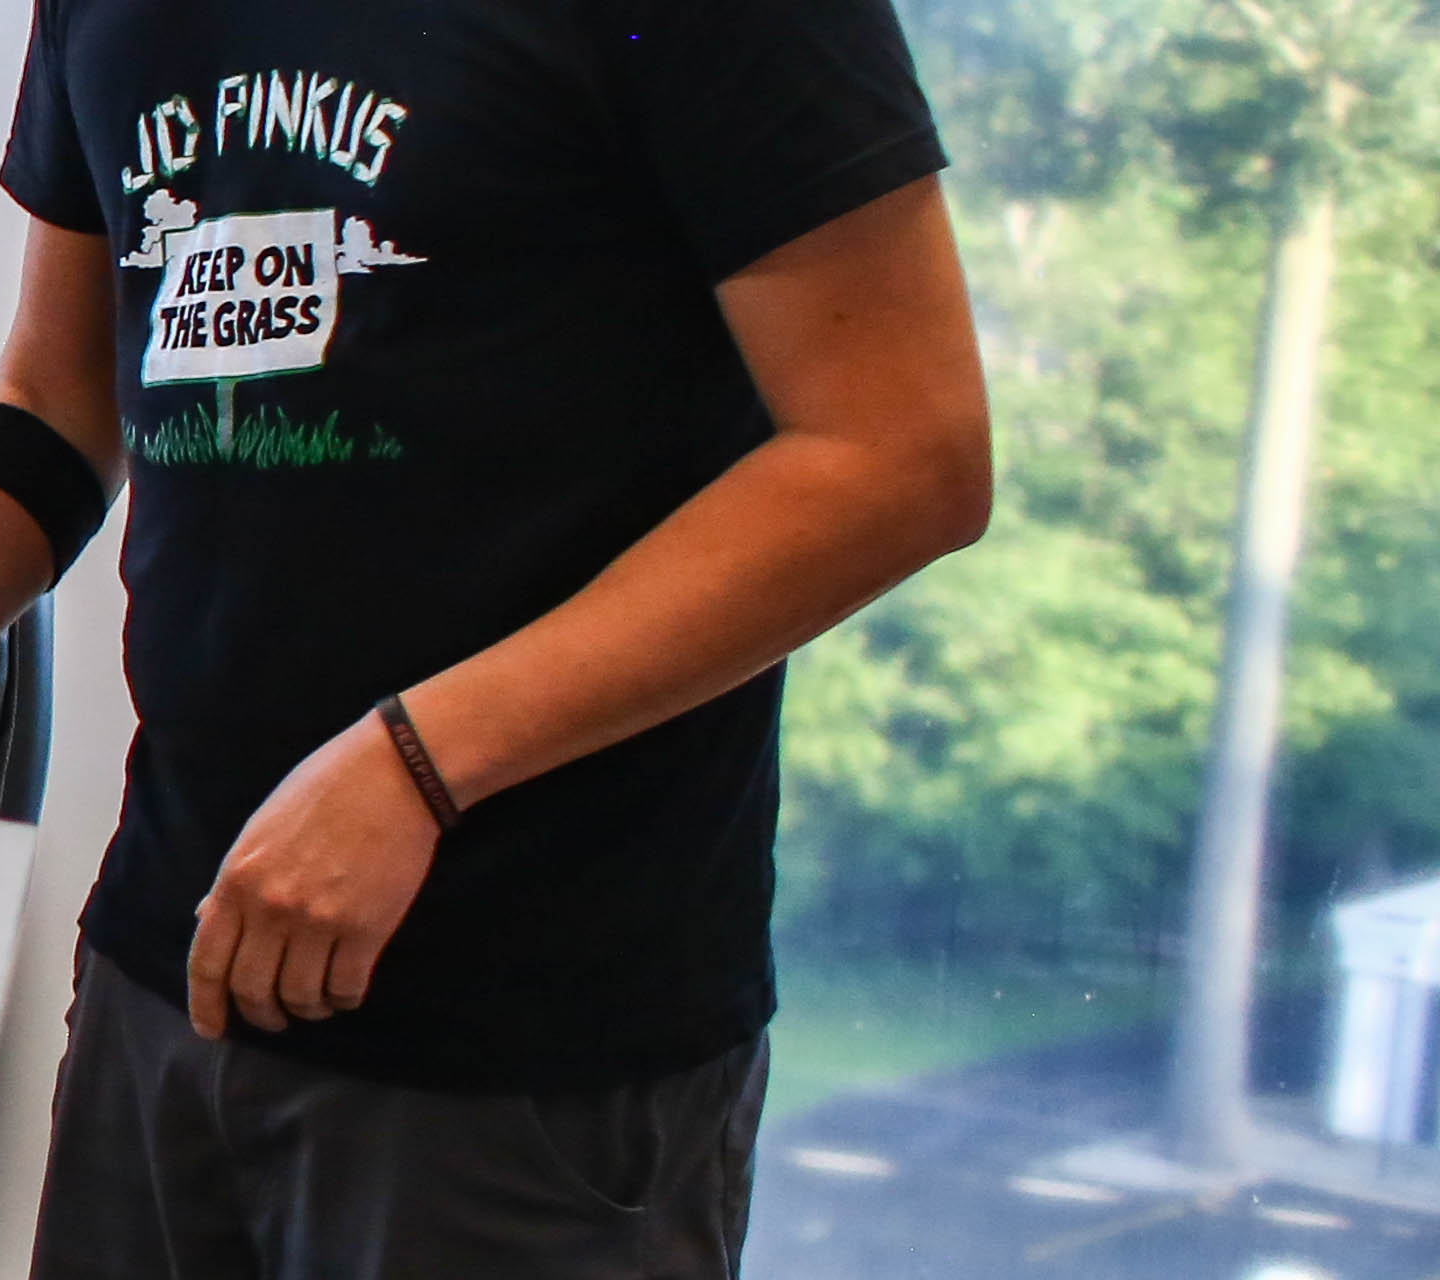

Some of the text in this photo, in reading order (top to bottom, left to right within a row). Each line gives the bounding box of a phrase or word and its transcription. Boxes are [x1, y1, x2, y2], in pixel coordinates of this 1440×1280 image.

[120, 68, 409, 195] JD PINKUS
[176, 242, 316, 298] KEEP ON
[159, 294, 323, 355] THE GRASS
